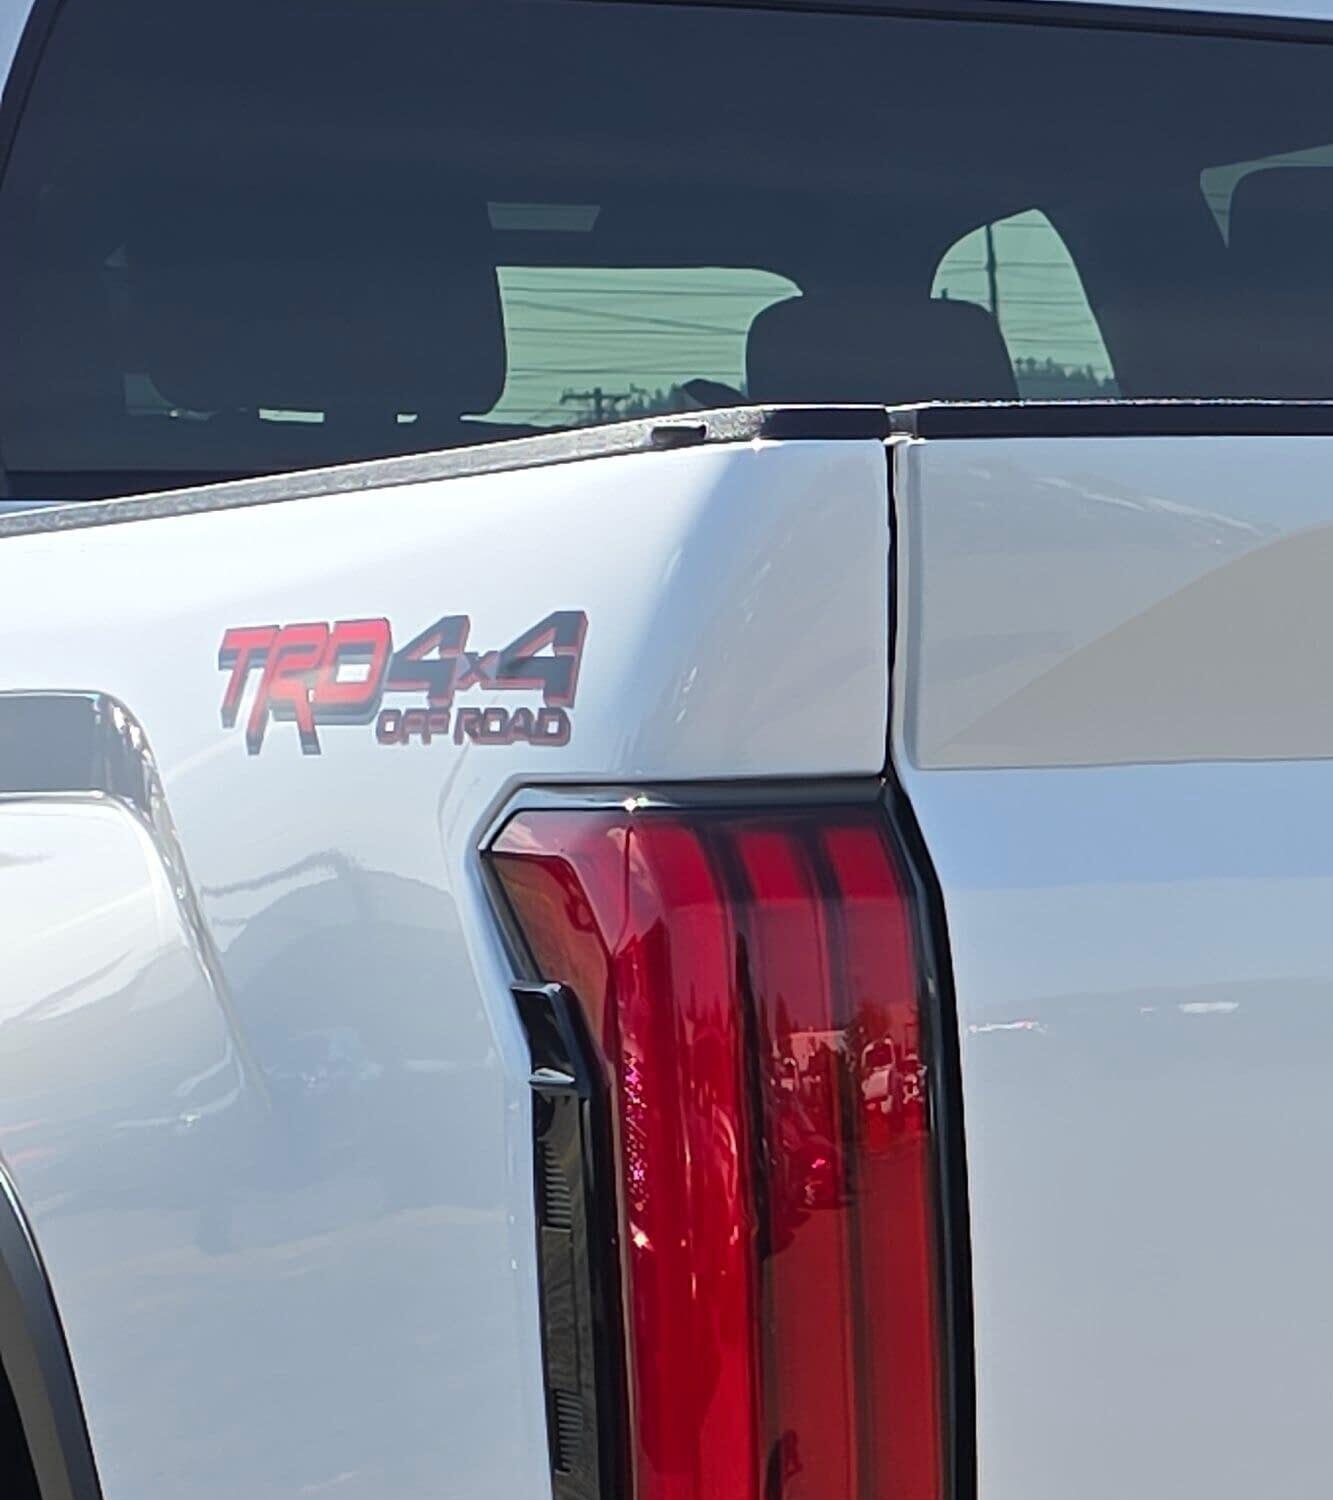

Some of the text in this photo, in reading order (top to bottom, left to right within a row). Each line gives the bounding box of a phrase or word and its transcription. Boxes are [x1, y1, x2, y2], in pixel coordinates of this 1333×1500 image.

[218, 610, 589, 755] TRD 4x4
[376, 706, 571, 748] OFF ROAD
